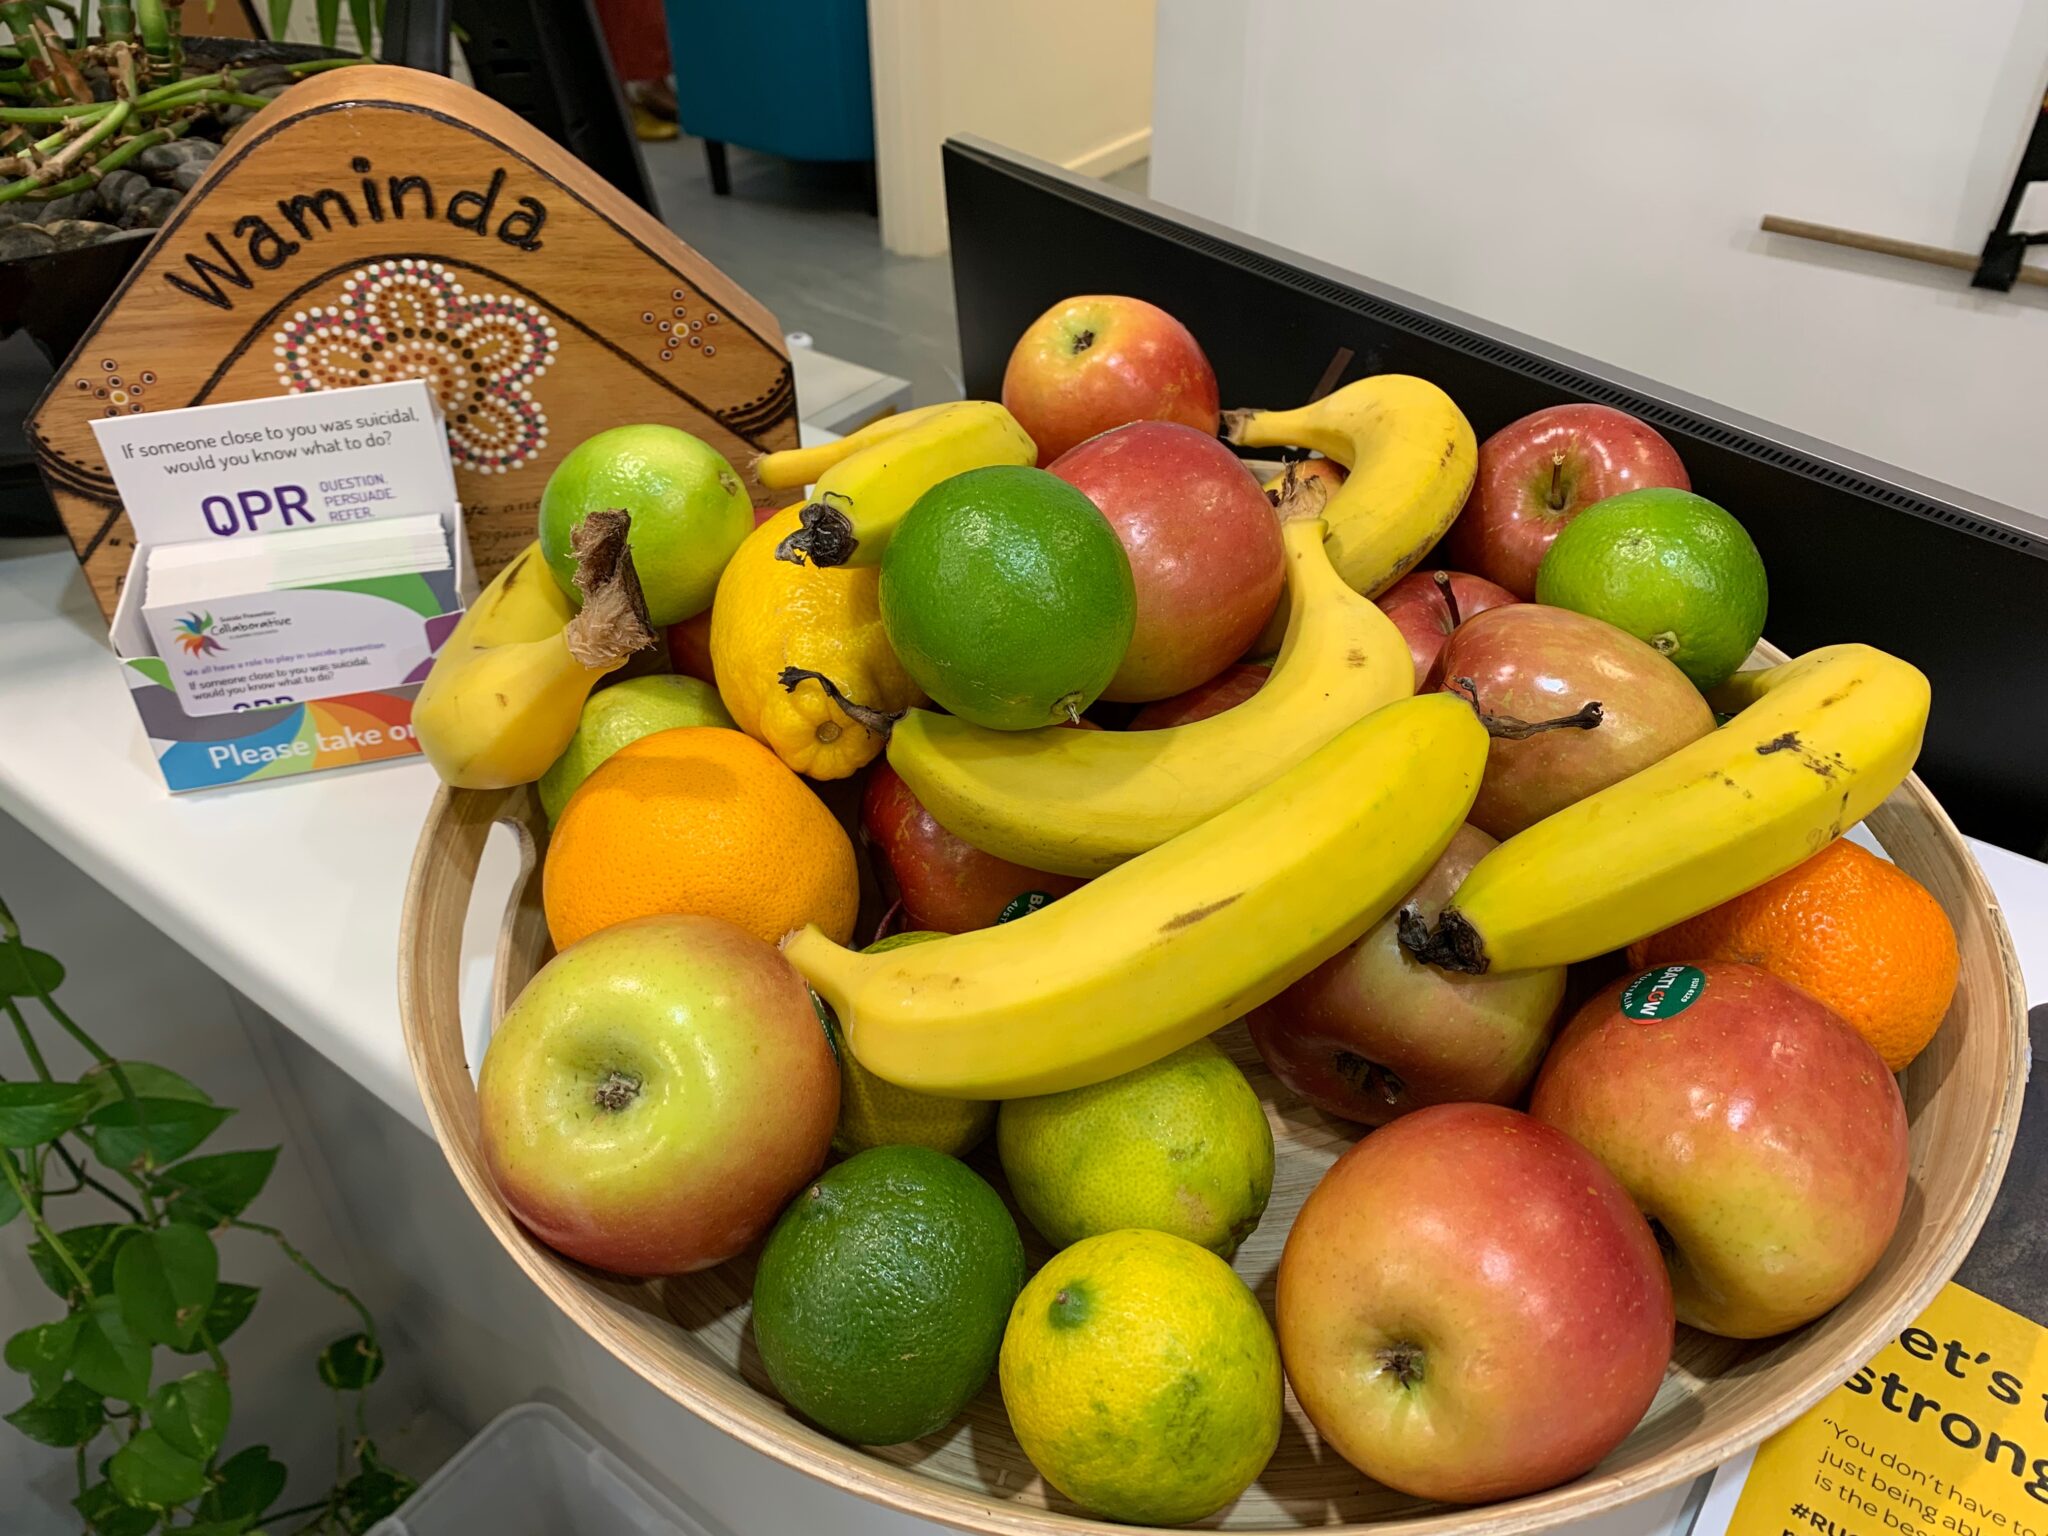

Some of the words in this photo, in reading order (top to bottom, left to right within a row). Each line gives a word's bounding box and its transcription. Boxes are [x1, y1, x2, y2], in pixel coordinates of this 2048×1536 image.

[163, 155, 548, 311] Waminda
[121, 444, 135, 459] If
[139, 436, 218, 457] someone
[220, 427, 264, 445] close
[265, 426, 284, 441] to
[286, 425, 317, 442] you
[320, 418, 354, 433] was
[163, 456, 217, 475] would
[219, 454, 251, 472] you
[252, 447, 298, 464] know
[300, 438, 342, 457] what
[345, 437, 362, 451] to
[364, 430, 393, 449] do?
[318, 473, 389, 494] QUESTION.
[323, 487, 398, 508] PERSUADE.
[200, 484, 316, 537] QPR
[328, 507, 376, 523] REFER.
[210, 616, 293, 637] Collaborative
[183, 668, 200, 677] We
[200, 665, 213, 675] all
[213, 663, 235, 674] have
[244, 658, 263, 668] role
[264, 656, 275, 665] to
[275, 654, 295, 666] play
[306, 648, 337, 658] suicide
[188, 681, 196, 691] If
[199, 674, 247, 690] someone
[247, 669, 275, 682] close
[276, 668, 288, 678] to
[288, 666, 308, 678] you
[309, 662, 330, 673] was
[192, 687, 226, 701] would
[226, 684, 246, 697] you
[247, 680, 276, 692] know
[276, 675, 302, 687] what
[304, 674, 316, 684] to
[316, 670, 335, 682] do?
[207, 741, 311, 769] Please
[314, 725, 384, 752] take
[1890, 1326, 2024, 1406] et's
[1814, 1469, 1833, 1492] is
[1838, 1485, 1878, 1517] the
[1818, 1446, 1867, 1483] just
[1871, 1472, 1940, 1525] being
[1880, 1454, 1944, 1495] don't
[1948, 1484, 2007, 1527] have
